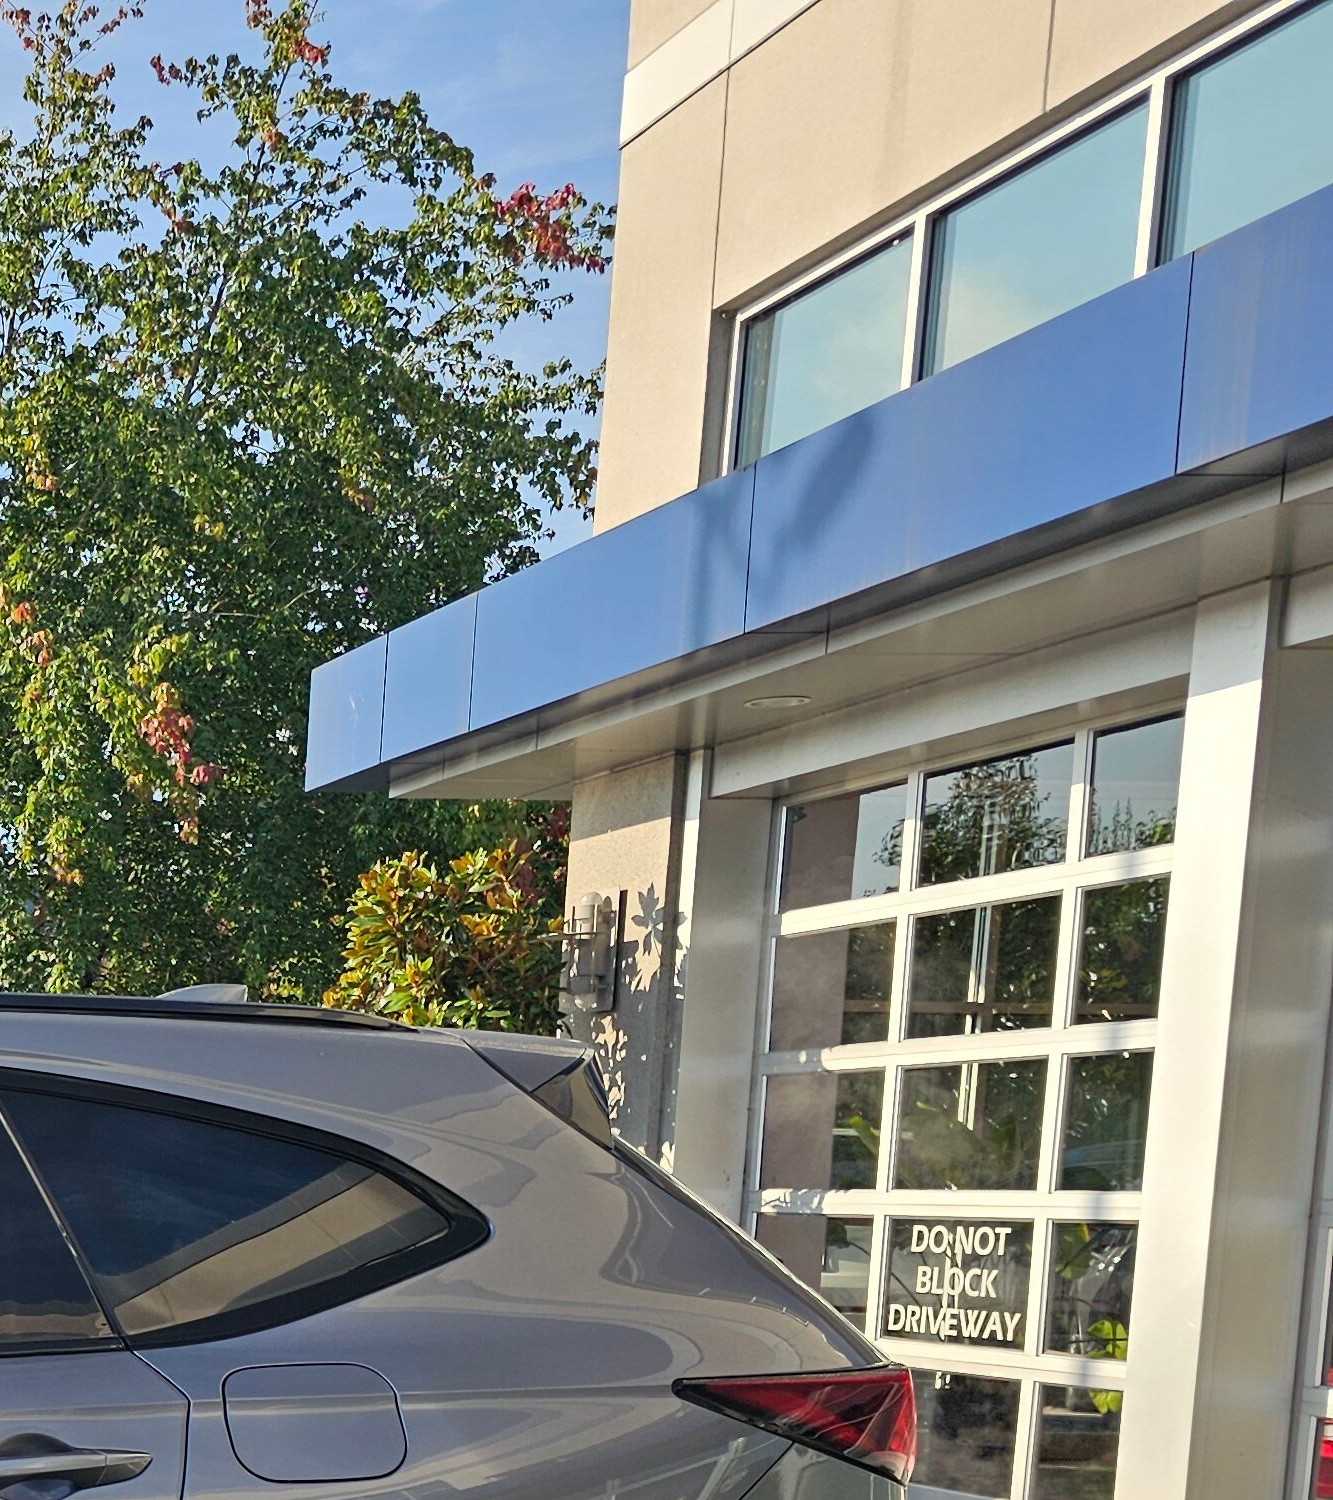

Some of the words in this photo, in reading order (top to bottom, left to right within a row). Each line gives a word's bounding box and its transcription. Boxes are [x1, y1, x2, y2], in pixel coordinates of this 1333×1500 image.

[910, 1224, 949, 1254] DO
[955, 1225, 1012, 1256] NOT
[915, 1265, 999, 1299] BLOCK
[887, 1303, 1022, 1342] DRIVEWAY
